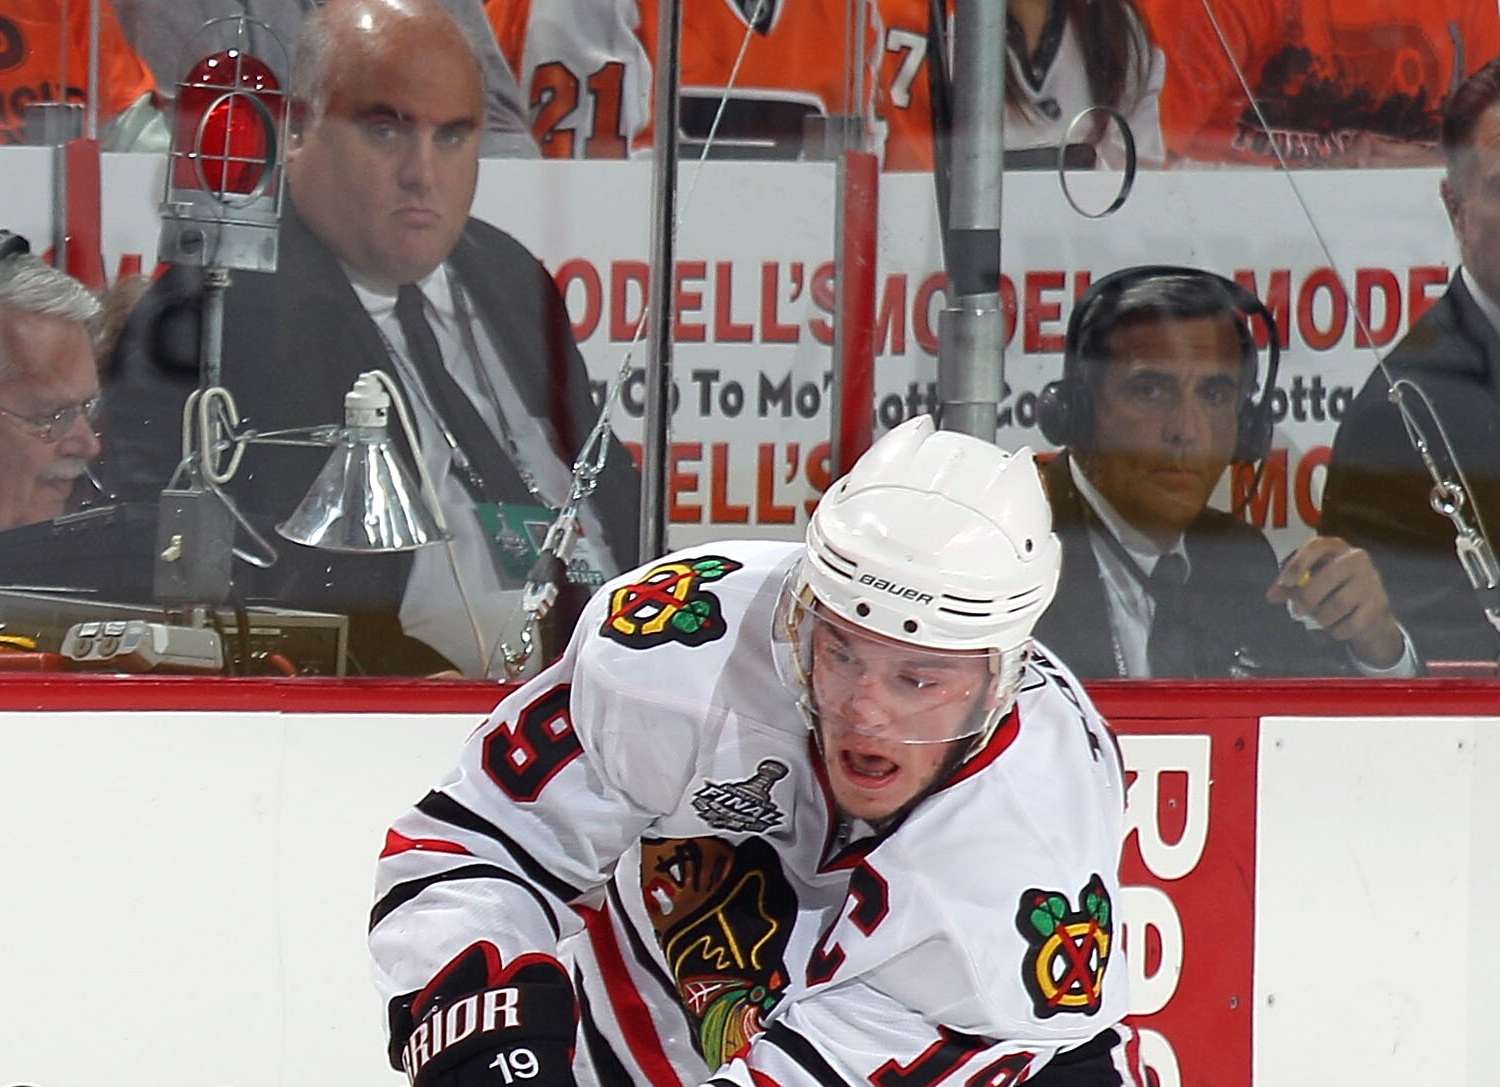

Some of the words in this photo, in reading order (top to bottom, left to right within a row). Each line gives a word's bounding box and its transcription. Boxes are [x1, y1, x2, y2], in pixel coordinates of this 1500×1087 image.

[529, 60, 628, 159] 21
[554, 257, 835, 346] ODELL'S
[1233, 264, 1449, 351] MODE
[691, 368, 745, 419] To
[757, 368, 833, 419] Mo'
[873, 381, 944, 429] ott
[1269, 375, 1354, 424] otta
[622, 440, 833, 524] ELL'
[859, 573, 934, 605] BAUER
[472, 682, 586, 803] 9
[699, 786, 777, 825] FINAL
[805, 857, 890, 988] C
[402, 987, 522, 1087] RIOR
[488, 1047, 541, 1085] 19
